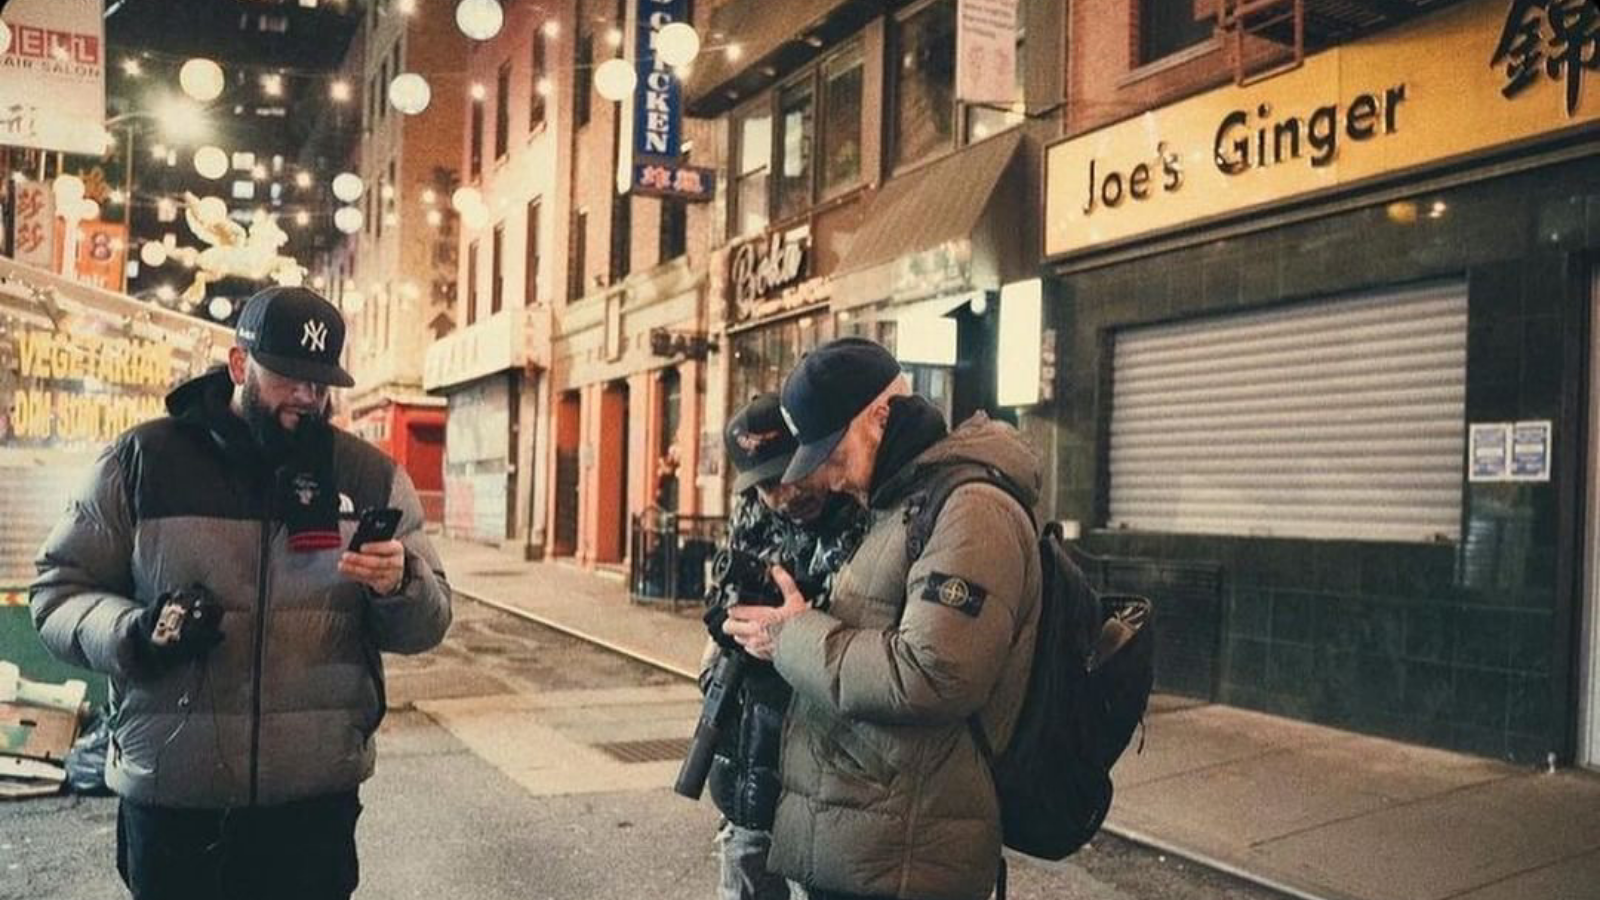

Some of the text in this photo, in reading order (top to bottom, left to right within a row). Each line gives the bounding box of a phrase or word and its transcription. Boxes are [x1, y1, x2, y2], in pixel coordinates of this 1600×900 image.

[1083, 82, 1407, 215] Joe's Ginger
[301, 318, 329, 352] NY
